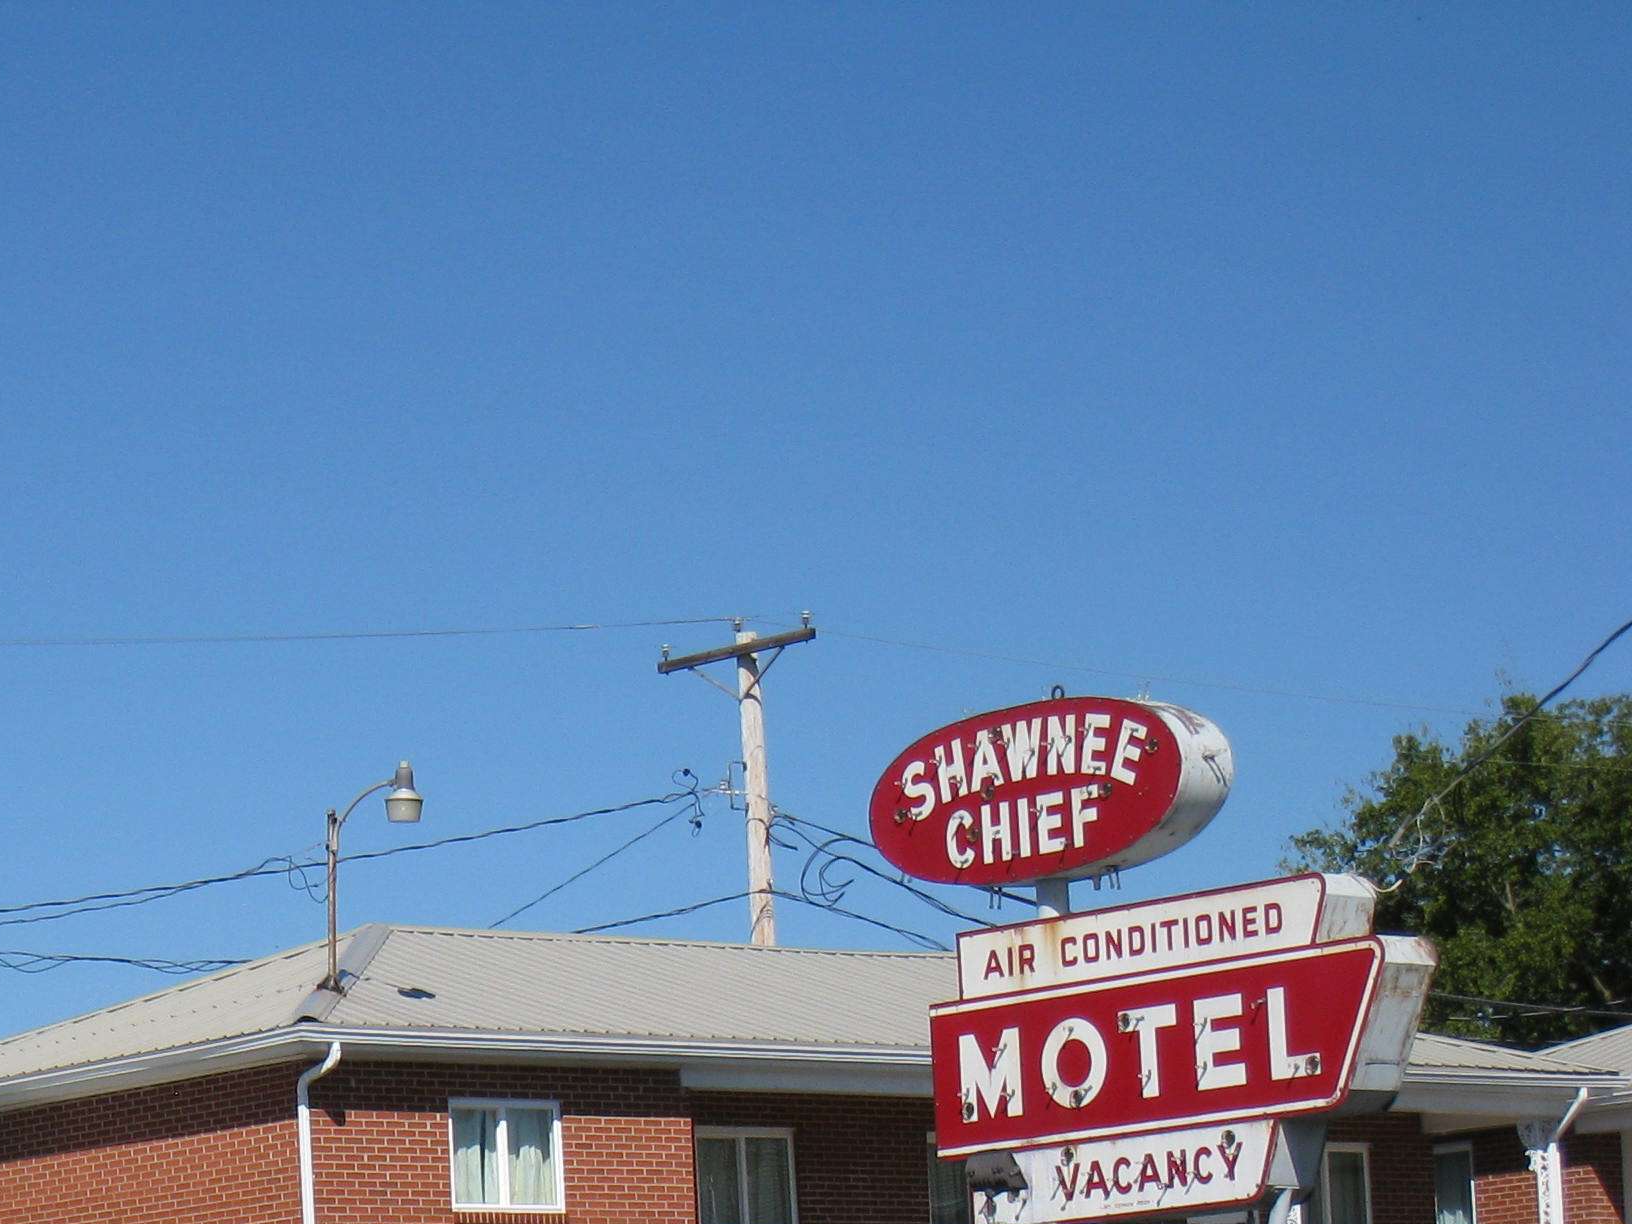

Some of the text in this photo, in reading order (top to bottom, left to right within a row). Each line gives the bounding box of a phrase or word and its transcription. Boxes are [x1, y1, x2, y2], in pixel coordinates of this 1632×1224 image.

[901, 713, 1148, 821] SHAWNEE
[946, 783, 1099, 869] CHIEF
[983, 902, 1284, 981] AIR CONDITIONED
[958, 986, 1321, 1124] MOTEL
[1055, 1141, 1243, 1201] VACANCY
